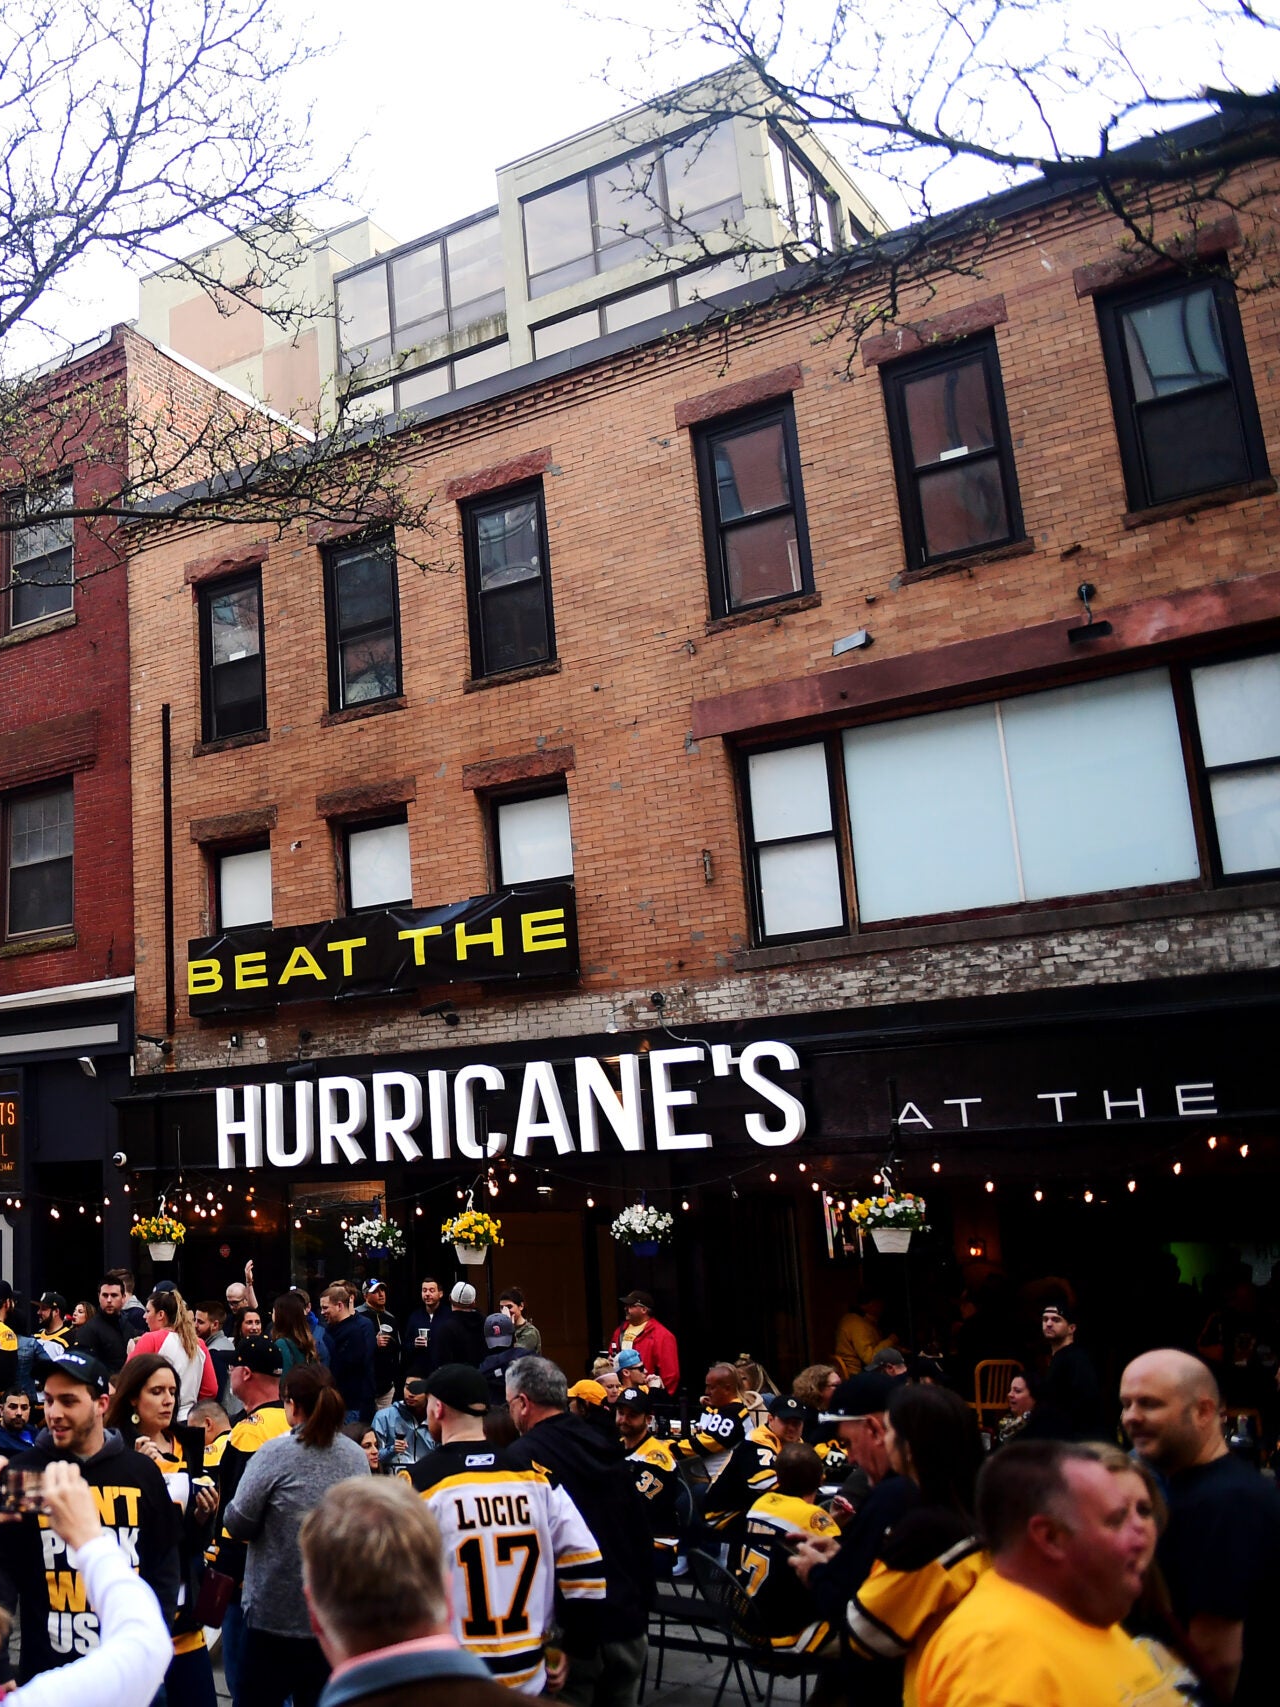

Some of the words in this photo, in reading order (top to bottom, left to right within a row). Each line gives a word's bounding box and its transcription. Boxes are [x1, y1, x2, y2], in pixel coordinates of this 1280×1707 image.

[187, 937, 366, 995] BEAT
[398, 908, 567, 967] THE
[215, 1040, 806, 1169] HURRICANE'S
[897, 1097, 982, 1130] AT
[1036, 1083, 1218, 1123] THE
[708, 1413, 735, 1438] 88
[635, 1470, 664, 1500] 37
[454, 1495, 531, 1531] LUCIC
[455, 1529, 540, 1640] 17
[735, 1545, 770, 1597] 7
[47, 1611, 101, 1655] US
